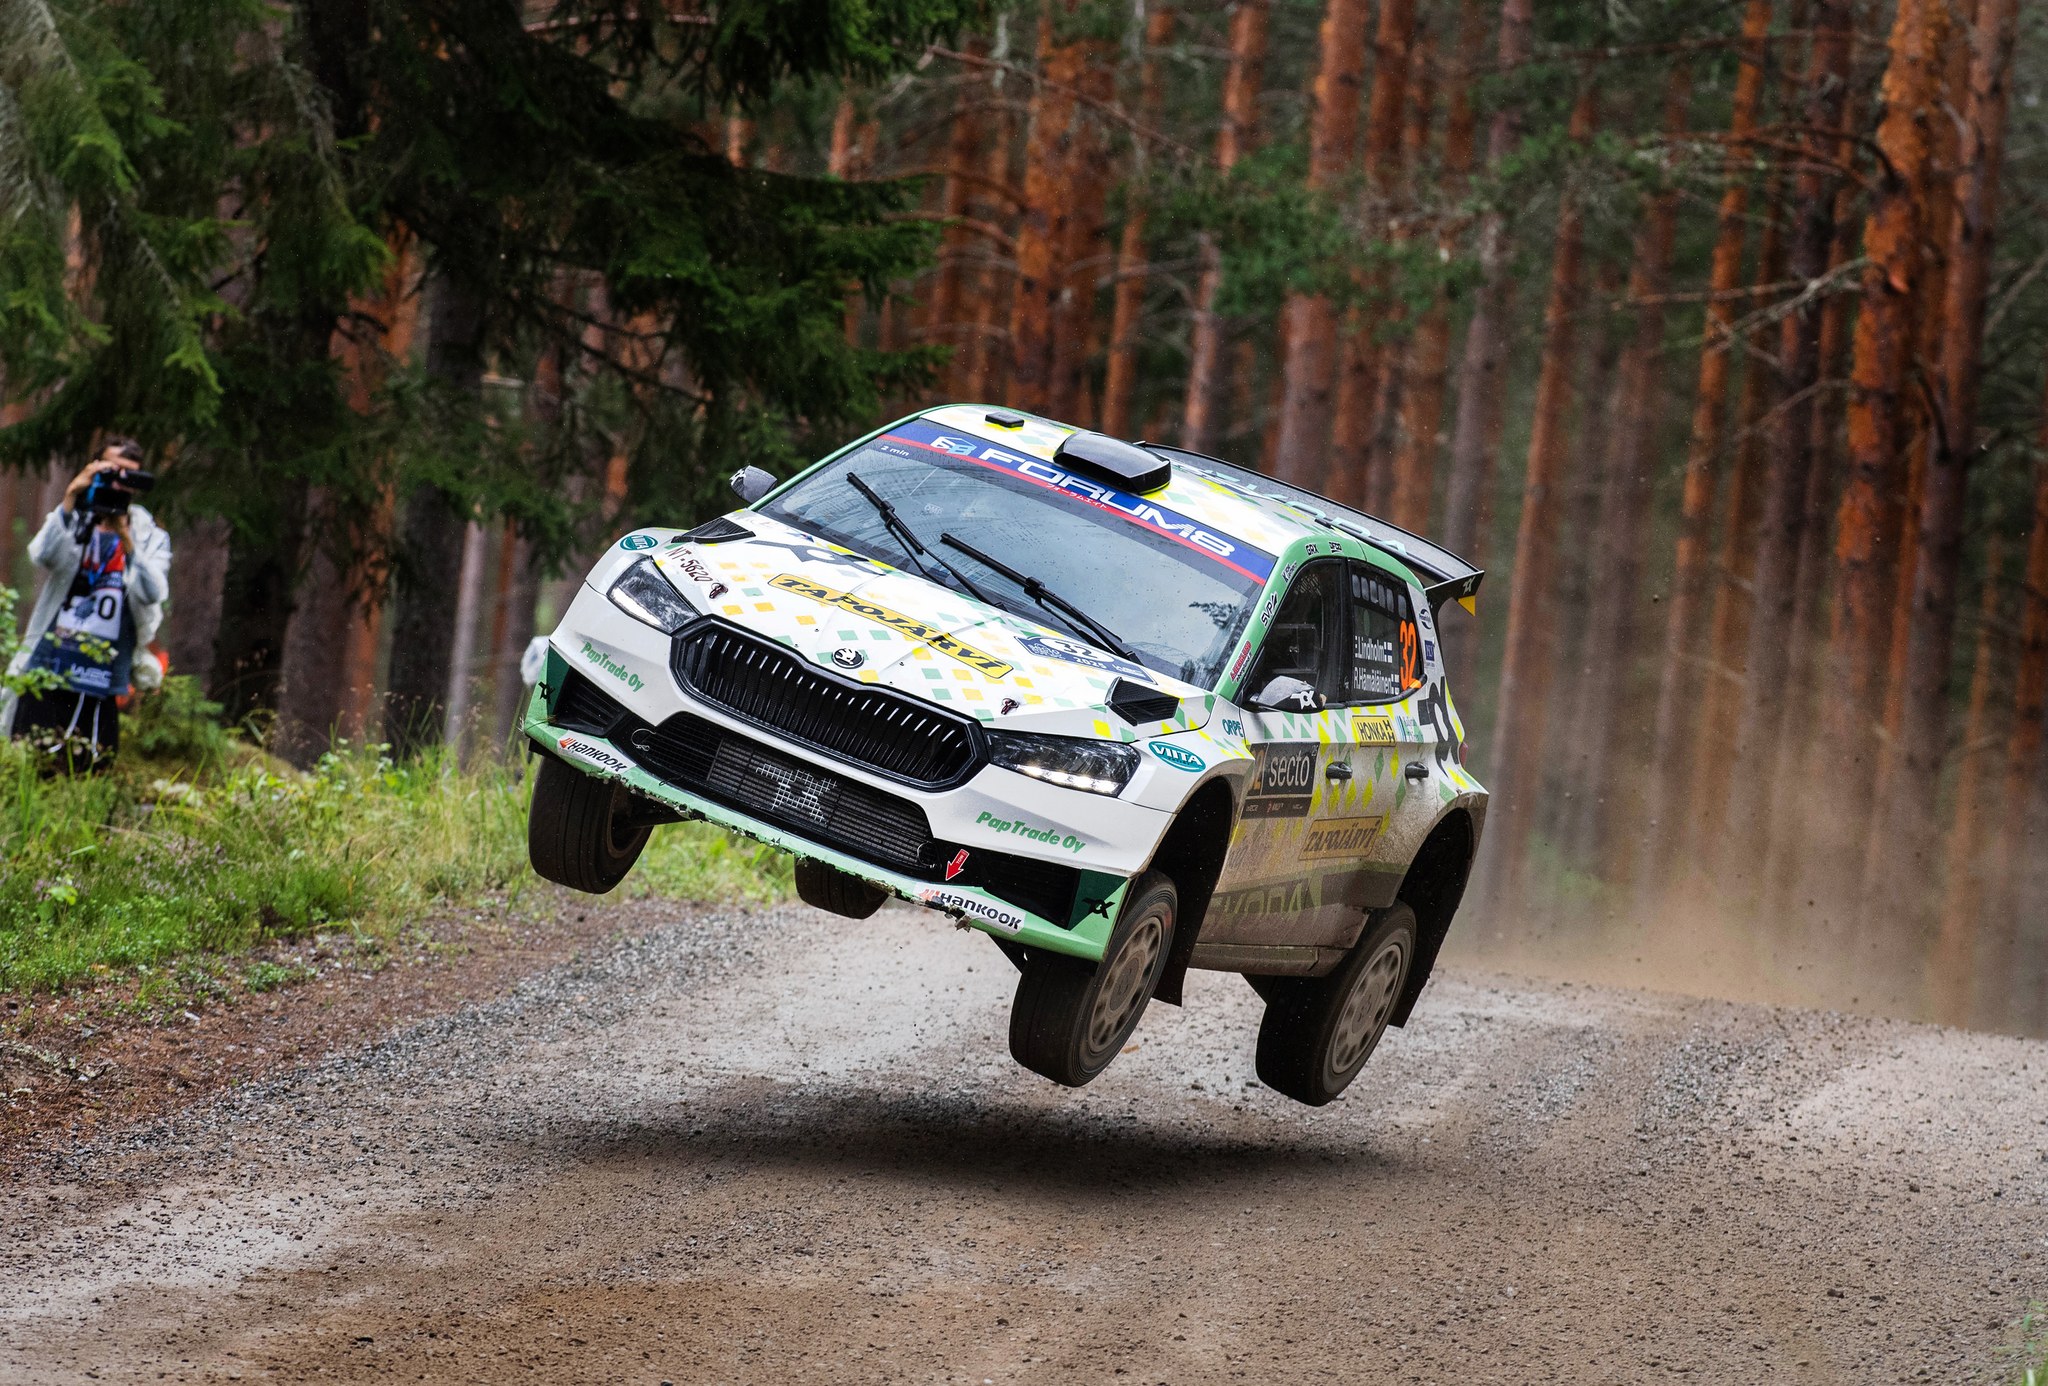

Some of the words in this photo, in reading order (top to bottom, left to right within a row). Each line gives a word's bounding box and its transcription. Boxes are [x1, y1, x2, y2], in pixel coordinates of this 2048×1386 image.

[978, 448, 1235, 557] FORUM8
[580, 641, 629, 682] PapTrade
[629, 673, 645, 693] Oy
[1054, 640, 1098, 659] 32
[1400, 620, 1421, 691] 32
[1151, 744, 1203, 767] VIITA
[1268, 750, 1310, 787] secto
[975, 810, 1061, 846] PapTrade
[1062, 835, 1086, 854] Oy
